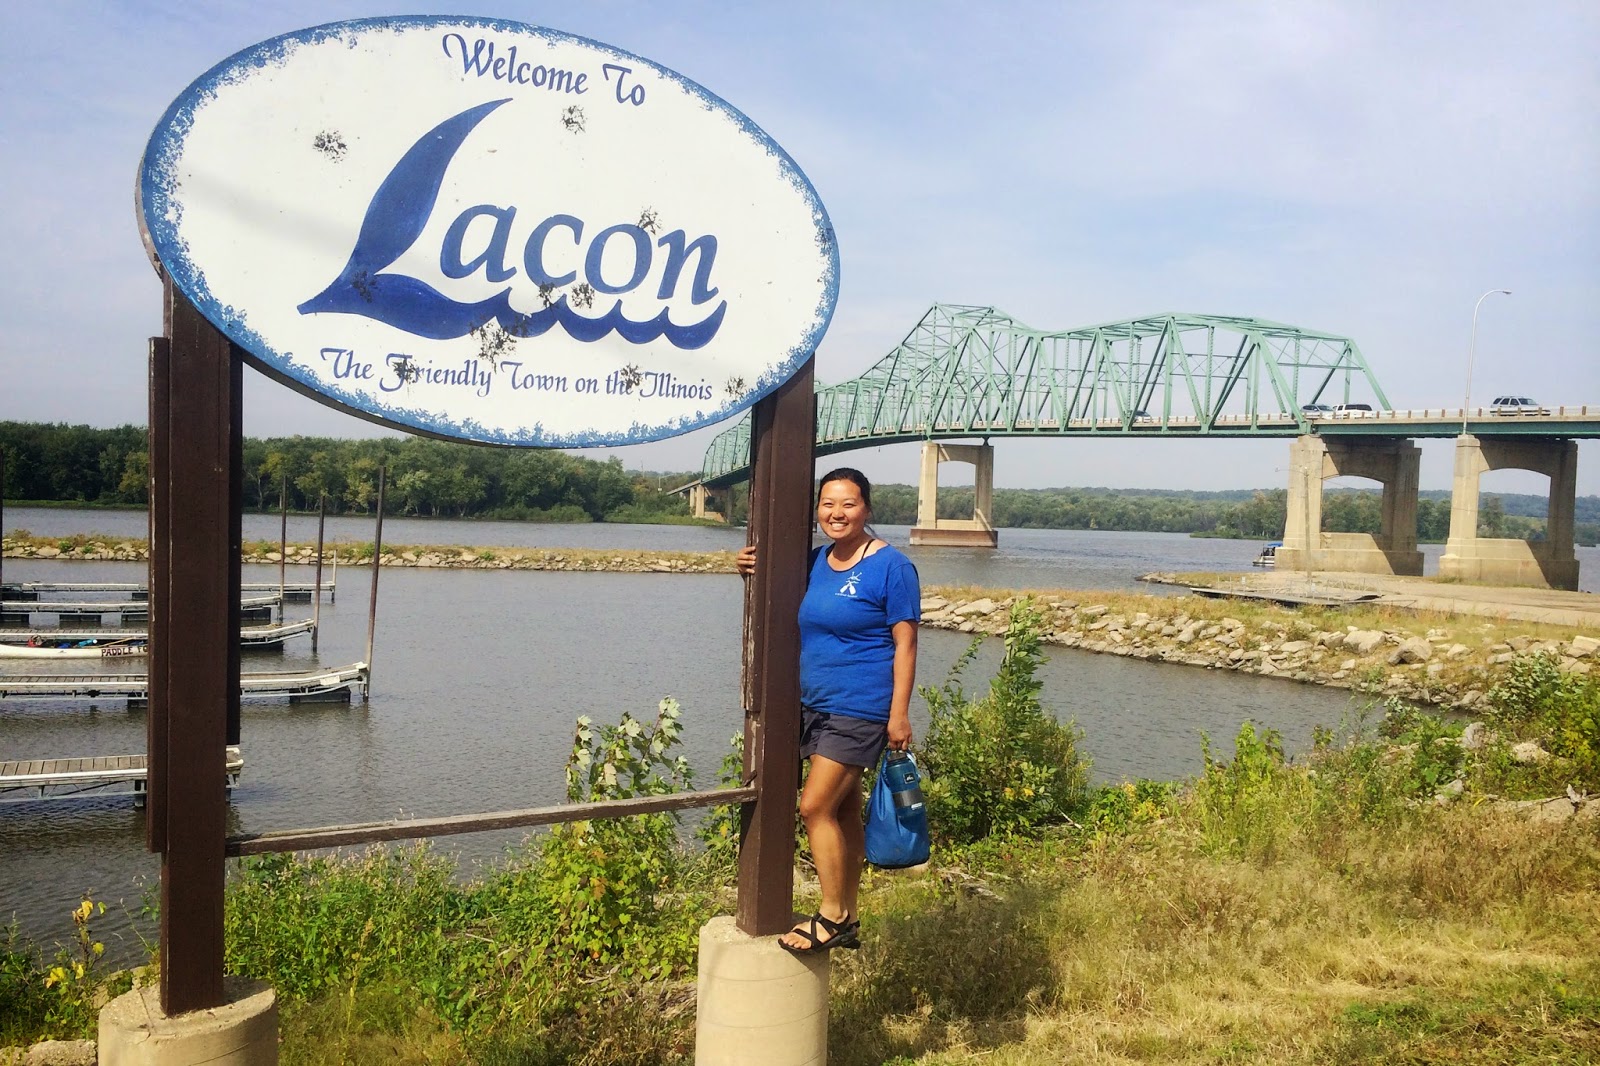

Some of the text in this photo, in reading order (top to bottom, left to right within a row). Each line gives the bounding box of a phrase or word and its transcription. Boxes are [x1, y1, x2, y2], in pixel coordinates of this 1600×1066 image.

[442, 33, 646, 107] Welcome To
[297, 97, 728, 350] Lacon
[320, 347, 713, 400] The Friendly Town on the Illinois
[101, 646, 134, 657] PADDLE
